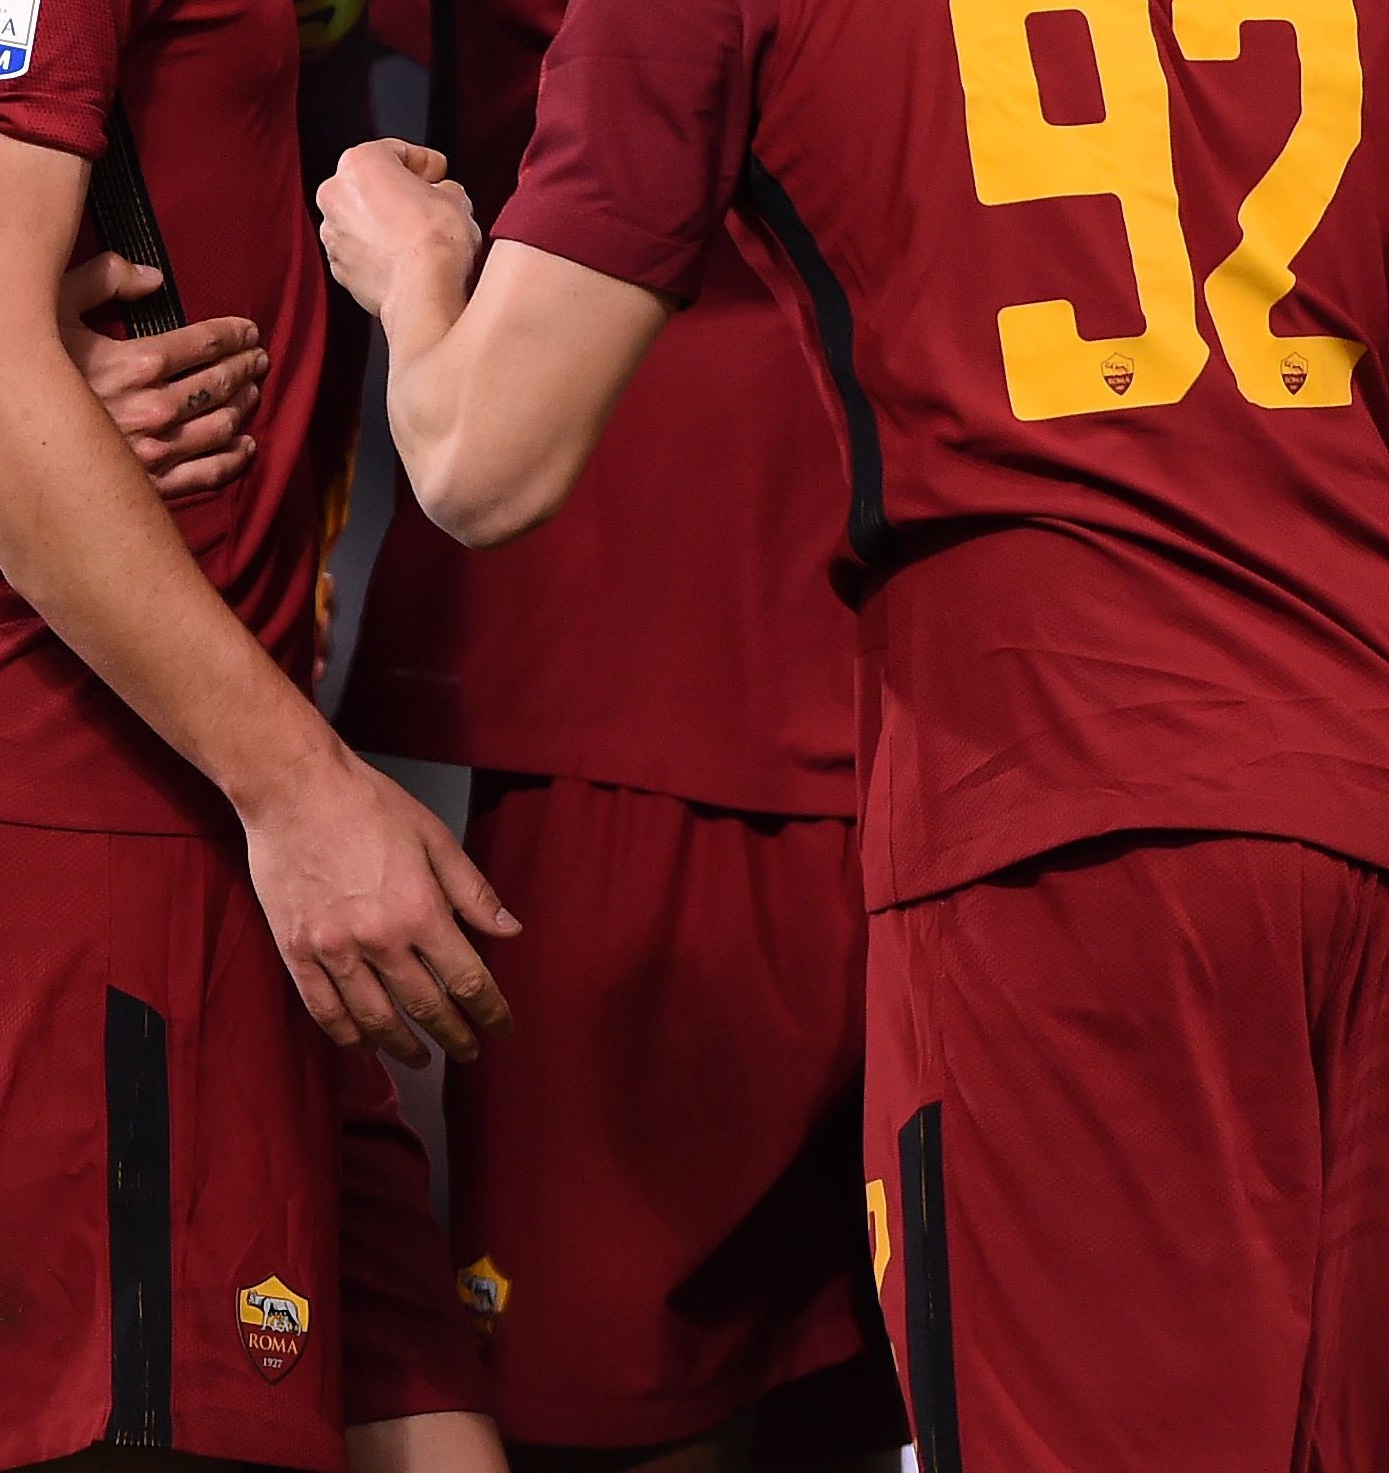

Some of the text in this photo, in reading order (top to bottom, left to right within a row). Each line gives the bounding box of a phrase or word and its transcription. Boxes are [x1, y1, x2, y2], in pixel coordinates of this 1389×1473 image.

[1, 17, 16, 37] A
[248, 1332, 298, 1356] ROMA
[263, 1357, 283, 1368] 1927
